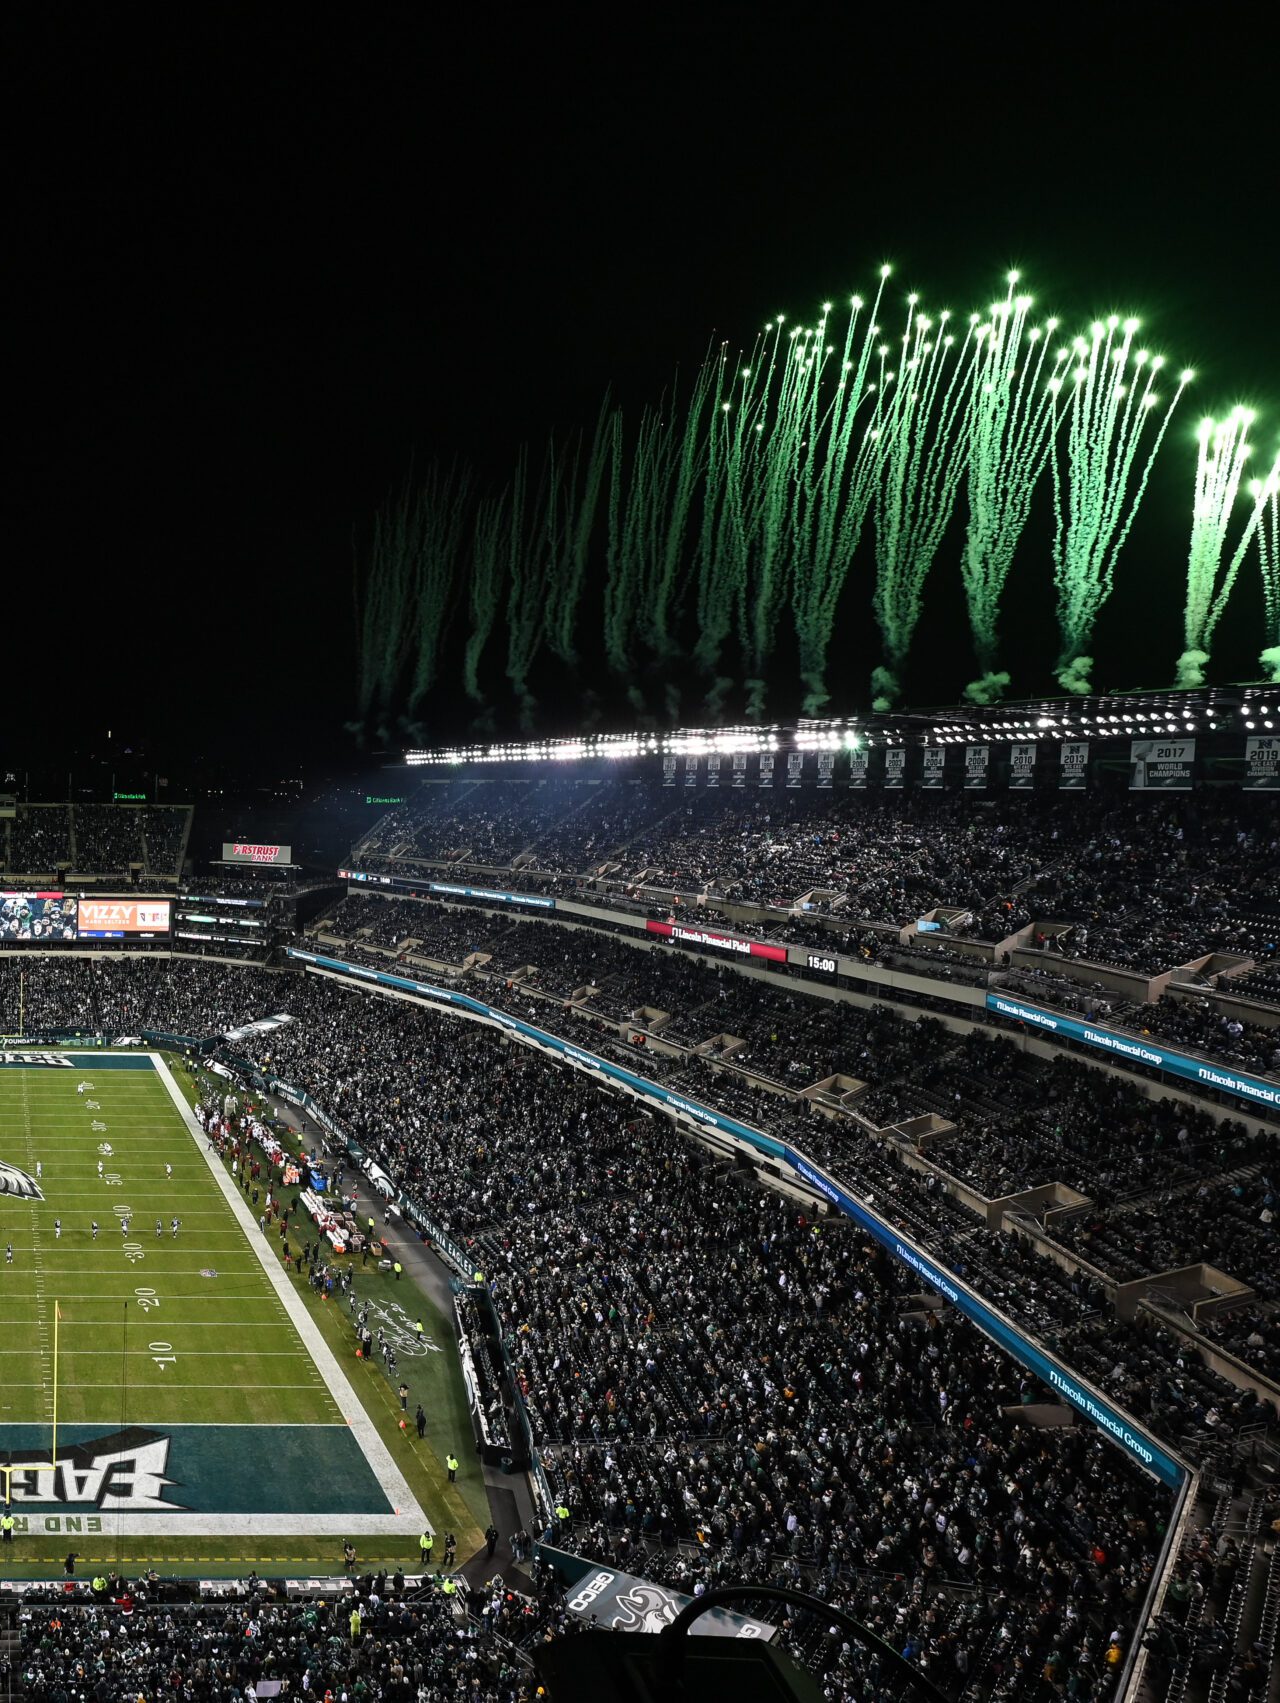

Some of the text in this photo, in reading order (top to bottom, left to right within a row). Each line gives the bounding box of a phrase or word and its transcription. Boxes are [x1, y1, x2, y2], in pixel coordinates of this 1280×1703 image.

[968, 757, 986, 765] 2006
[1014, 756, 1032, 764] 2010
[1064, 755, 1084, 763] 2013
[1157, 748, 1185, 758] 2017
[1250, 751, 1278, 760] 2019
[926, 758, 942, 766] 2004
[233, 844, 278, 855] FRSTRUST
[80, 906, 136, 919] VIZZY
[679, 928, 750, 954] Lincoln Financial Field
[808, 956, 835, 972] 15:00
[1002, 1002, 1057, 1029] Lincoln Financial Group
[1090, 1032, 1162, 1064] Lincoln Financial Group
[1207, 1070, 1235, 1089] Lincoln
[1236, 1080, 1274, 1102] Financial
[105, 1174, 123, 1185] 50
[113, 1206, 133, 1219] 40
[407, 1201, 473, 1275] PHILADELPHIA EAGLES
[122, 1242, 145, 1259] 30
[902, 1248, 958, 1302] Lincoln Financial Group
[134, 1286, 161, 1308] 20
[148, 1341, 176, 1365] 10
[1058, 1377, 1152, 1463] Lincoln Financial Group
[44, 1516, 102, 1533] END
[568, 1572, 615, 1612] GEICO
